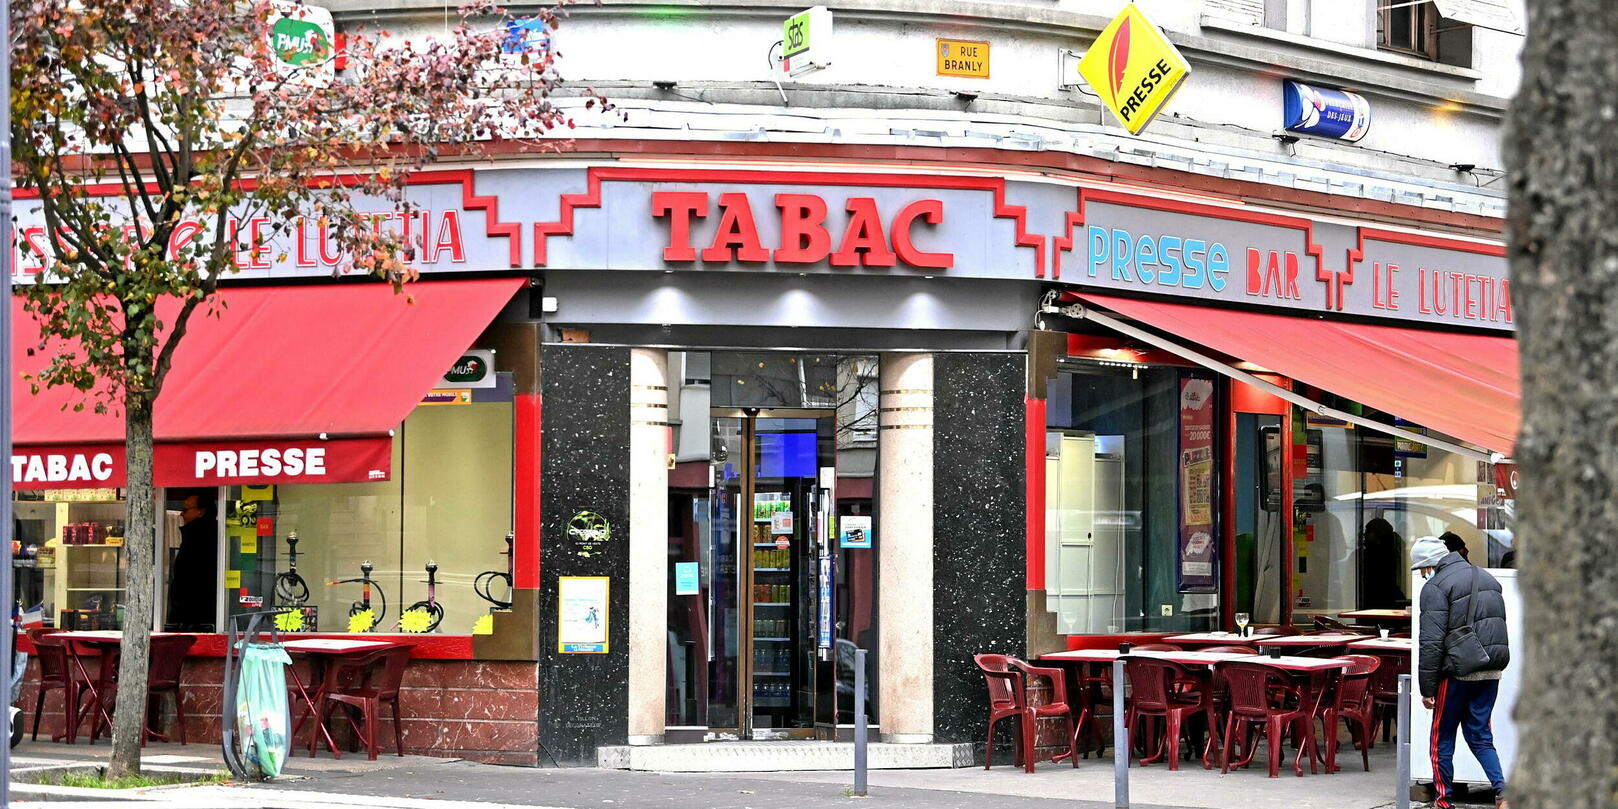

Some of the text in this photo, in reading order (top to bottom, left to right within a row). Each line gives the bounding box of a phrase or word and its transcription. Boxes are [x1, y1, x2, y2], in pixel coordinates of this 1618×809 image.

[944, 59, 983, 71] BRANLY
[960, 46, 978, 57] RUE
[1120, 59, 1171, 122] PRESSE
[229, 216, 271, 268] LE
[651, 191, 954, 268] TABAC
[1246, 247, 1301, 299] BAR
[1373, 262, 1513, 324] LE LUTETIA
[11, 447, 326, 482] TABAC PRESSE
